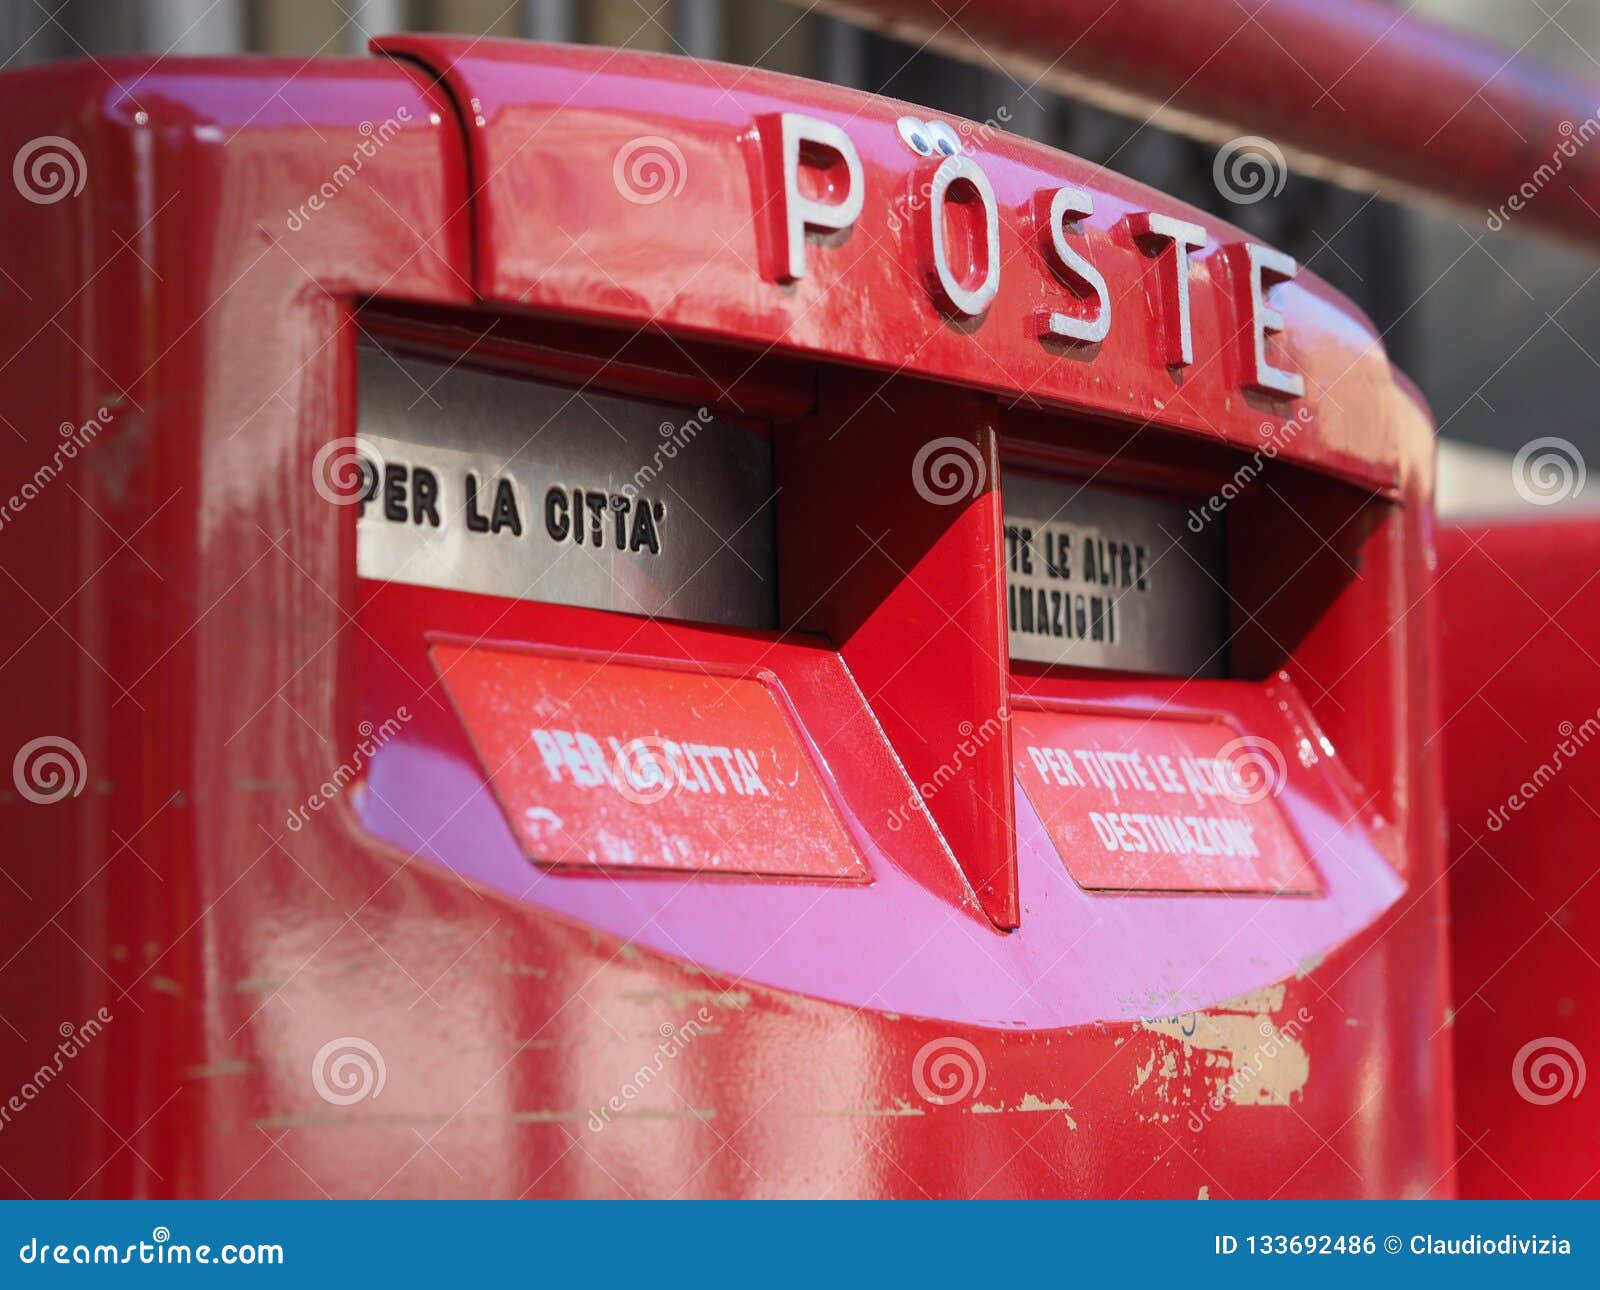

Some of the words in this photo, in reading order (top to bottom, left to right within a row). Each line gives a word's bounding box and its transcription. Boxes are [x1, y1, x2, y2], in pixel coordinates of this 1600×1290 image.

[776, 111, 1305, 398] POSTE
[357, 459, 440, 528] PER
[465, 473, 522, 536] LA
[1004, 526, 1033, 575] TE
[1045, 531, 1070, 579] LE
[1083, 537, 1146, 591] ALTRE
[531, 729, 622, 791] PER
[1027, 746, 1085, 787] PER
[1149, 754, 1185, 794] LE
